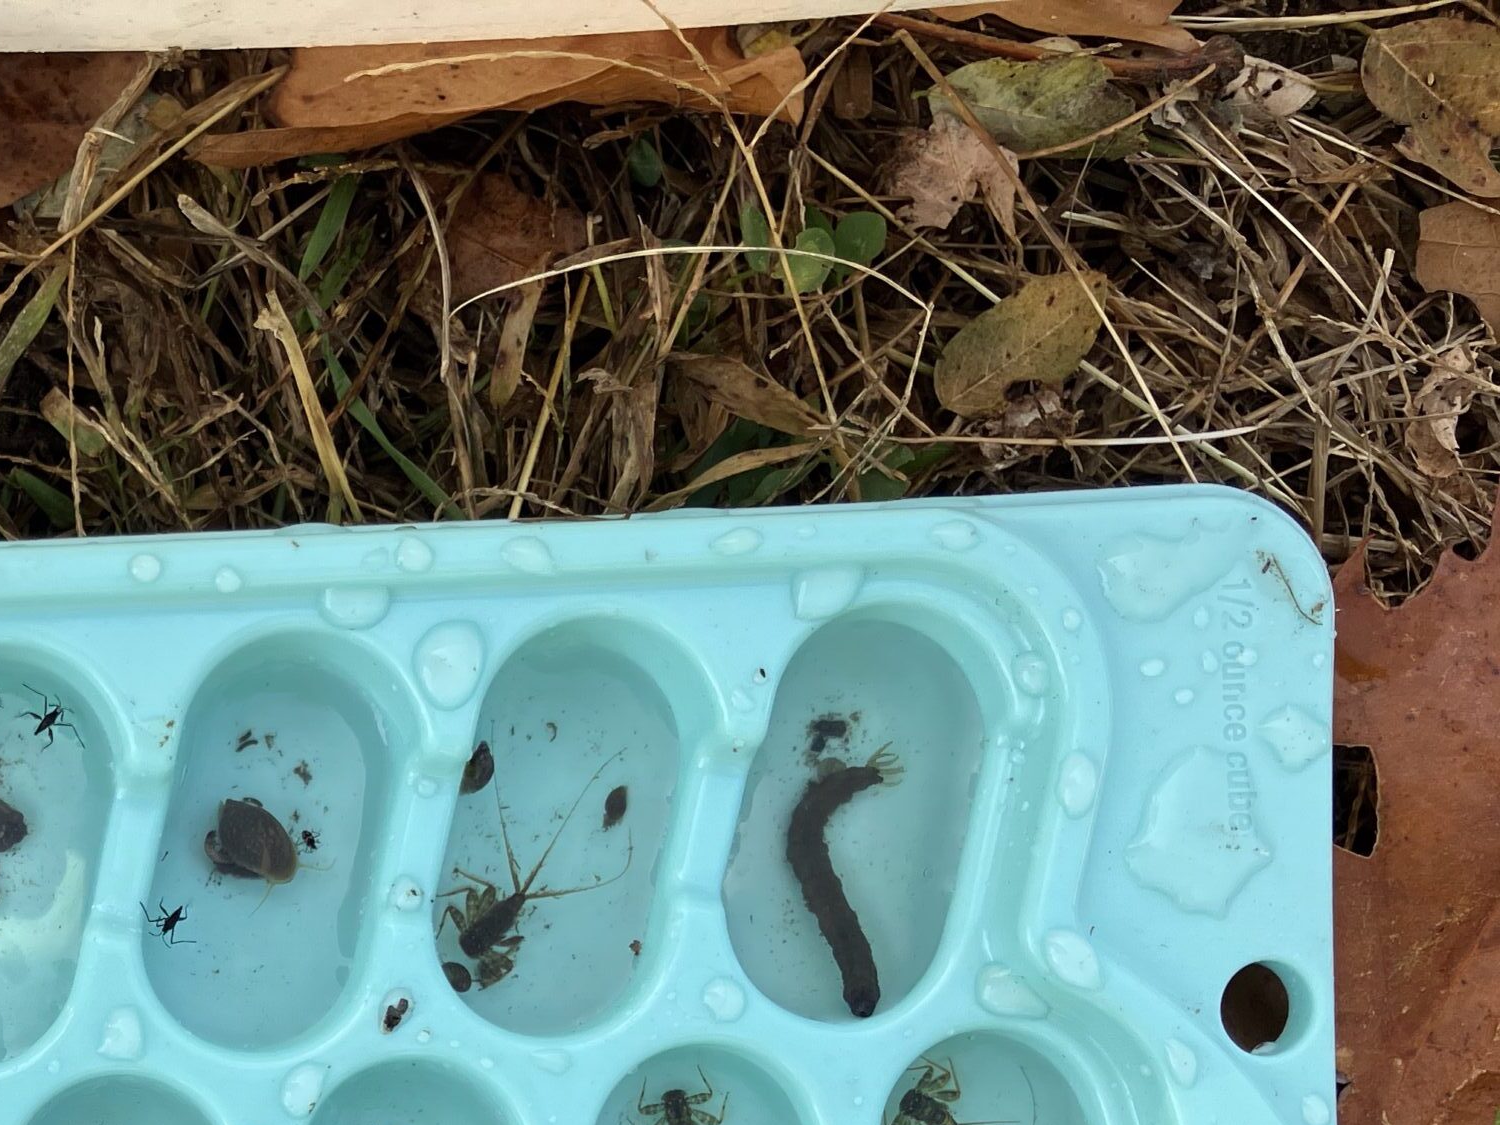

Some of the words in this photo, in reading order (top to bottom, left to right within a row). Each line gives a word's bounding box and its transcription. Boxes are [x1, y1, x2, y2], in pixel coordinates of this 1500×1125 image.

[1217, 576, 1255, 631] 1/2
[1221, 640, 1248, 742] ounce
[1226, 751, 1257, 833] cube
